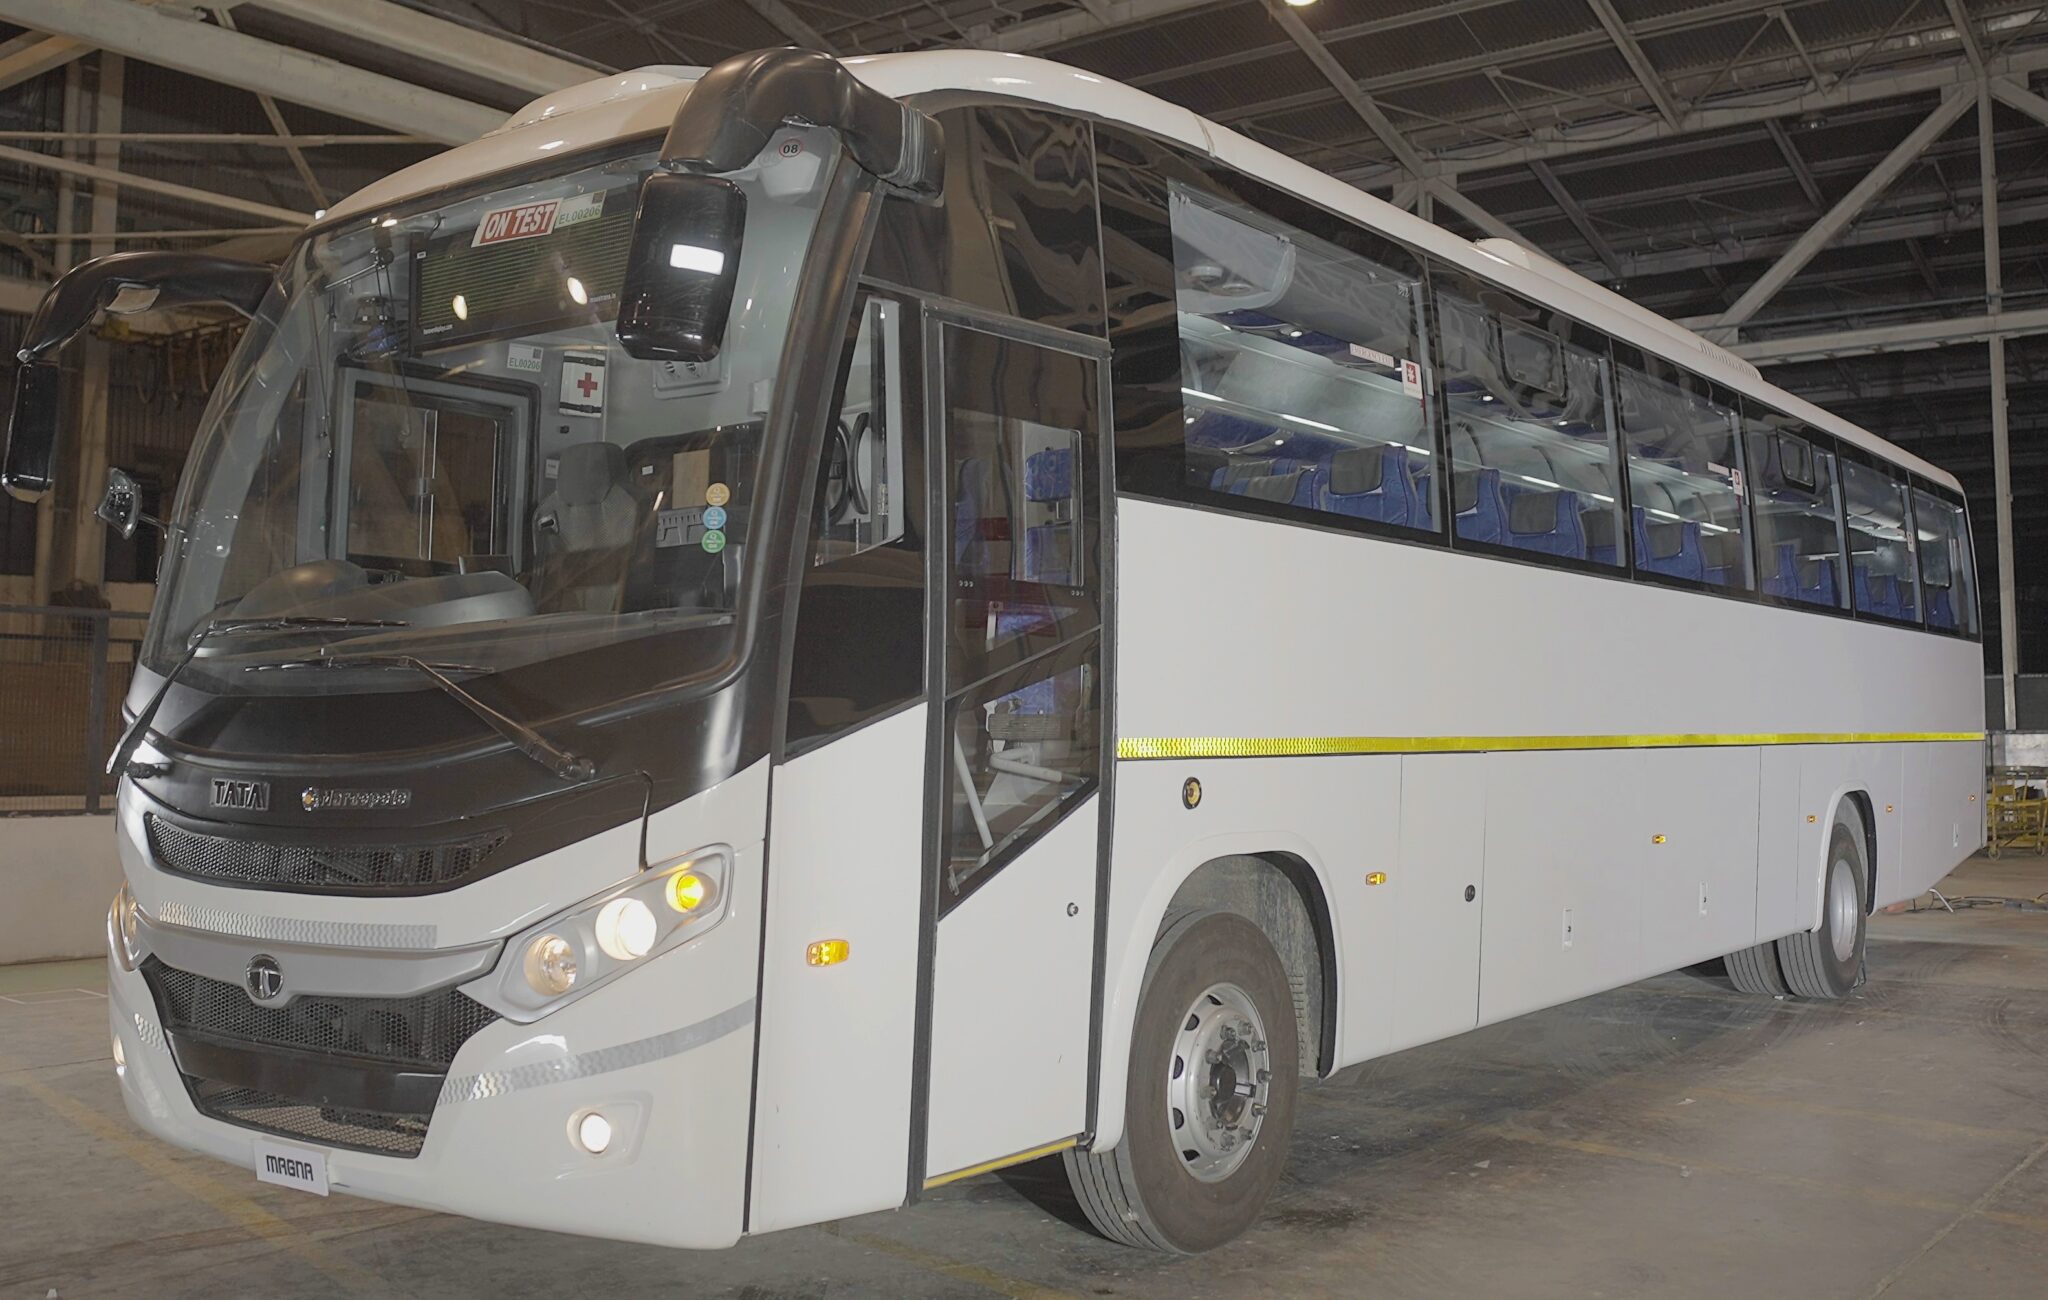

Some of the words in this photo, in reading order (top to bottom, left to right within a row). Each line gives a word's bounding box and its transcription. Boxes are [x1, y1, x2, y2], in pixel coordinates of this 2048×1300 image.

[783, 144, 798, 154] 08
[485, 211, 511, 239] ON
[512, 204, 556, 234] TEST
[559, 206, 601, 224] EL00206
[509, 357, 541, 370] EL00206
[212, 779, 269, 810] TATA
[266, 1154, 314, 1182] MAGNA
